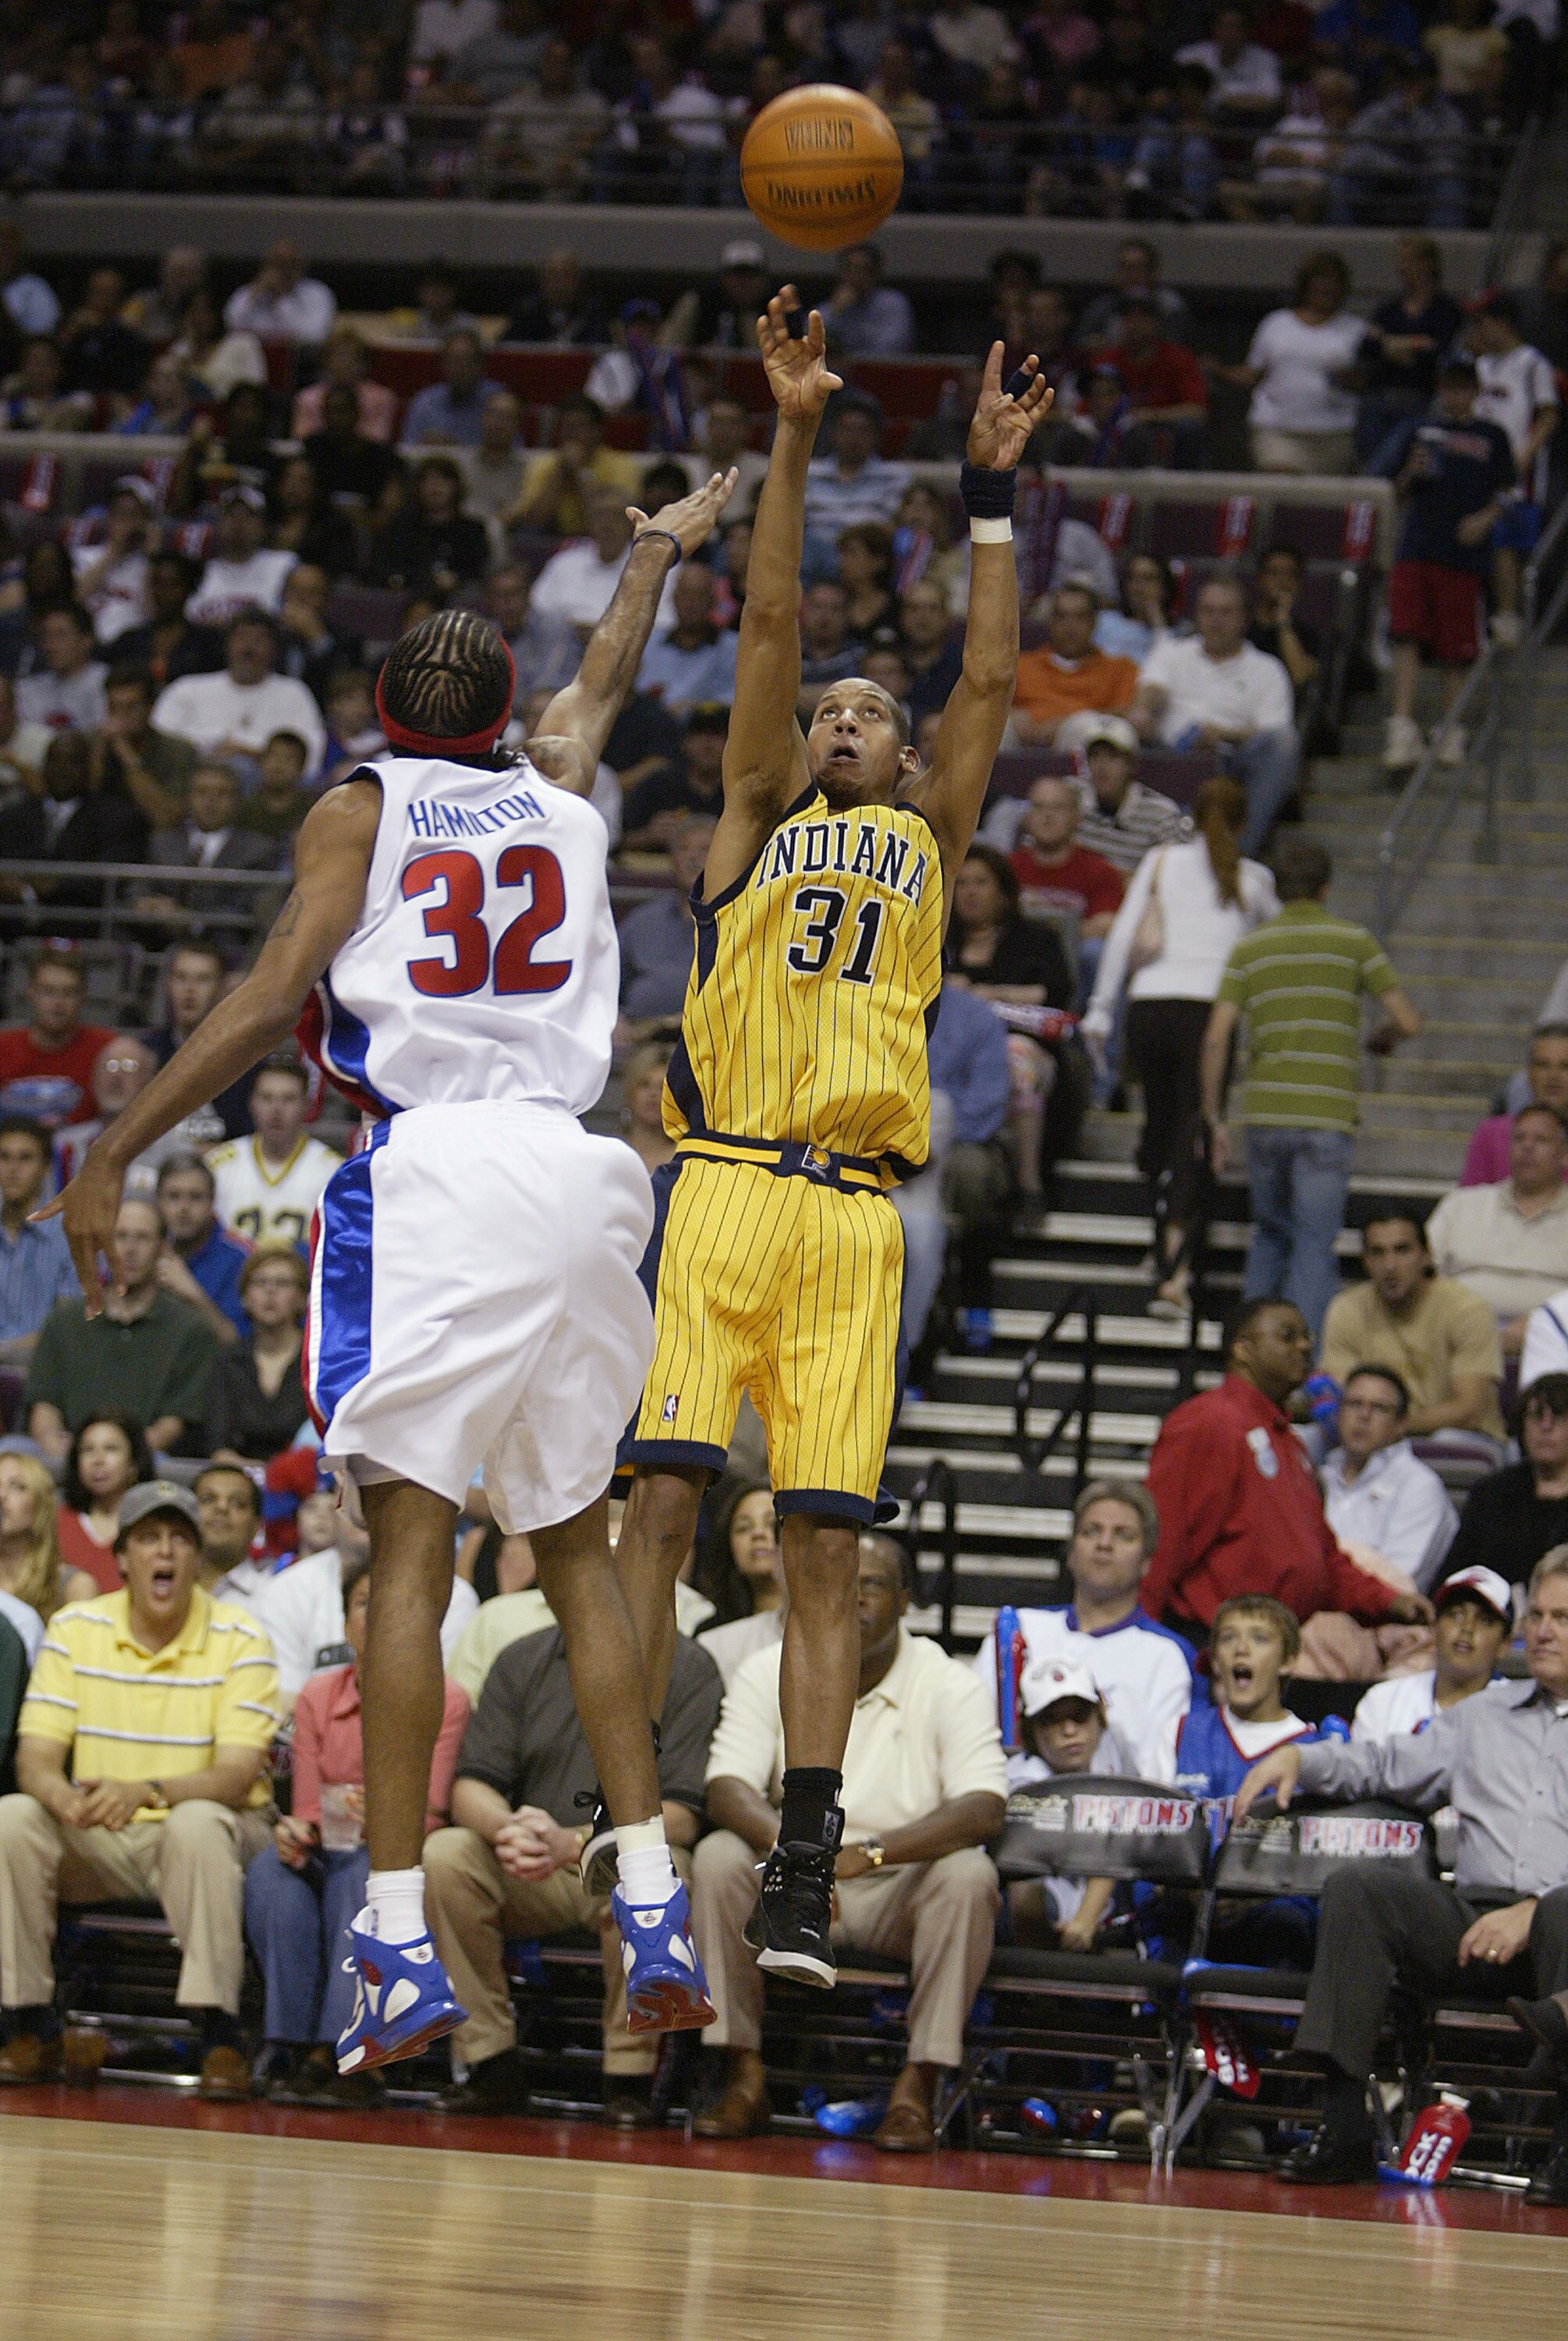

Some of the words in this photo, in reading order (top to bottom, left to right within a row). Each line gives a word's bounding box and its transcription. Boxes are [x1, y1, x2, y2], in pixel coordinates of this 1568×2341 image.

[407, 790, 545, 837] HAMILTON
[756, 821, 928, 910] INDIANA
[401, 844, 573, 998] 32
[787, 886, 885, 987] 31
[1072, 1794, 1198, 1833] PISTONS
[1298, 1816, 1424, 1857] PISTONS
